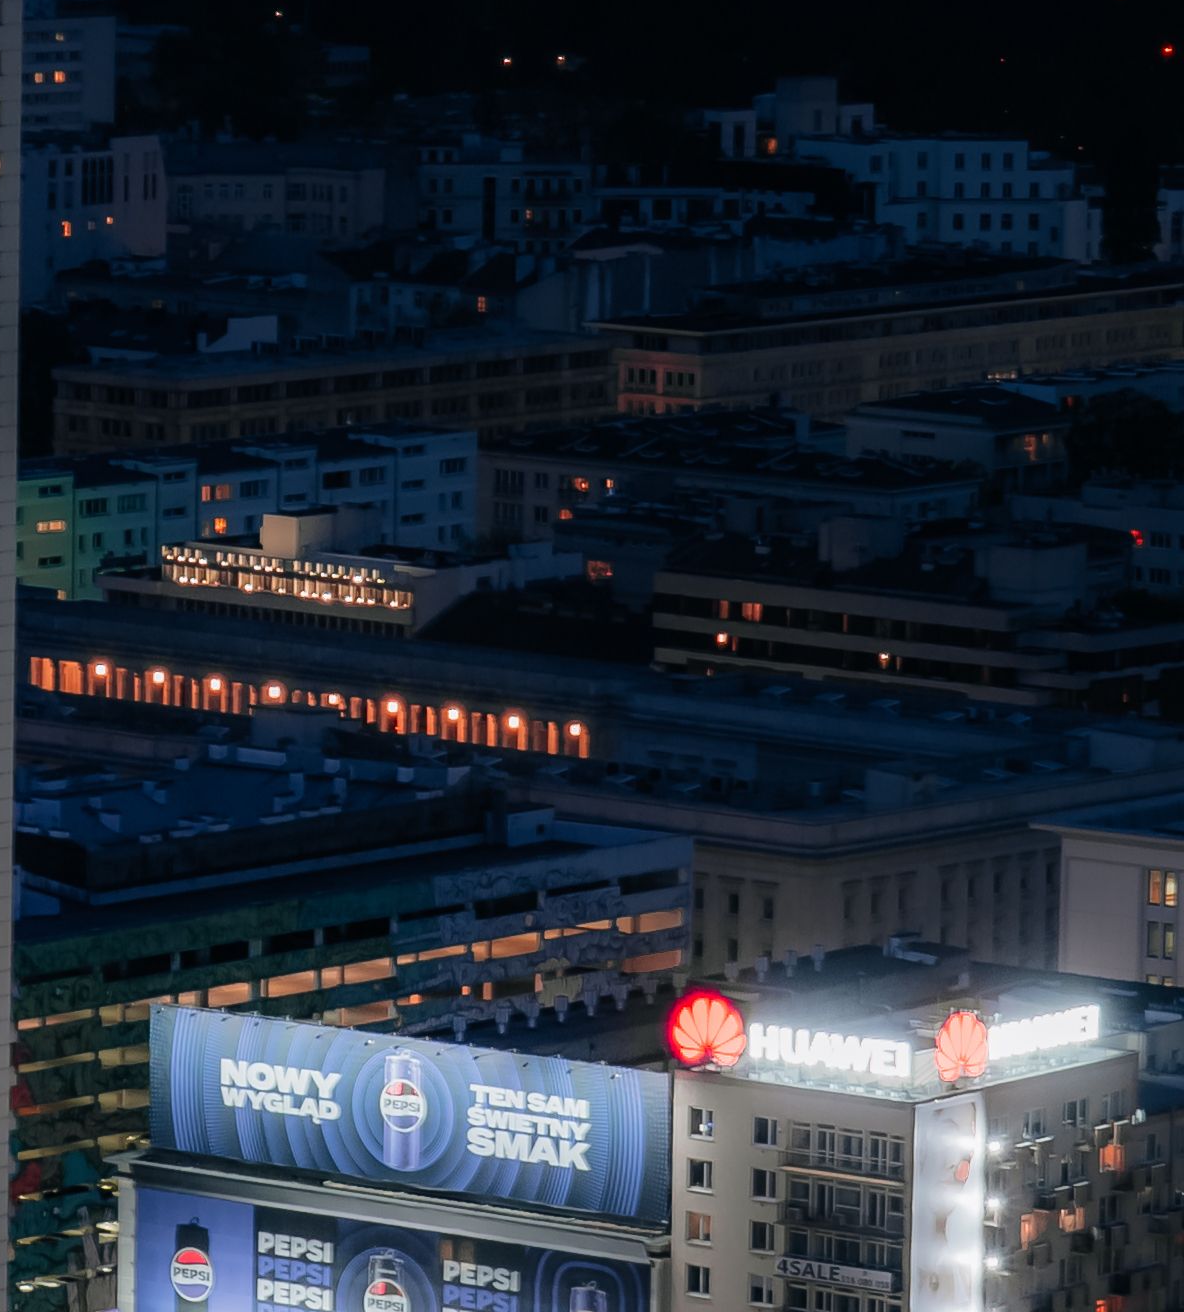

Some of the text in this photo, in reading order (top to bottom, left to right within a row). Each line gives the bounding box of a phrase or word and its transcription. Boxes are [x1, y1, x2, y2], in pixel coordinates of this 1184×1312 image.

[749, 1022, 911, 1077] HUAWEI
[220, 1058, 342, 1099] NOWY
[221, 1086, 342, 1124] WYGLĄD
[384, 1099, 420, 1113] PEPSI
[469, 1083, 590, 1119] TEN SAM
[467, 1104, 592, 1141] ŚWIETNY
[467, 1126, 592, 1171] SMAK
[258, 1231, 334, 1264] PEPSI
[174, 1267, 210, 1282] PEPSI
[257, 1255, 331, 1288] PEPSI
[443, 1259, 521, 1293] PEPSI
[776, 1259, 841, 1281] 4SALE
[257, 1278, 334, 1312] PEPSI
[368, 1297, 404, 1312] PEPSI
